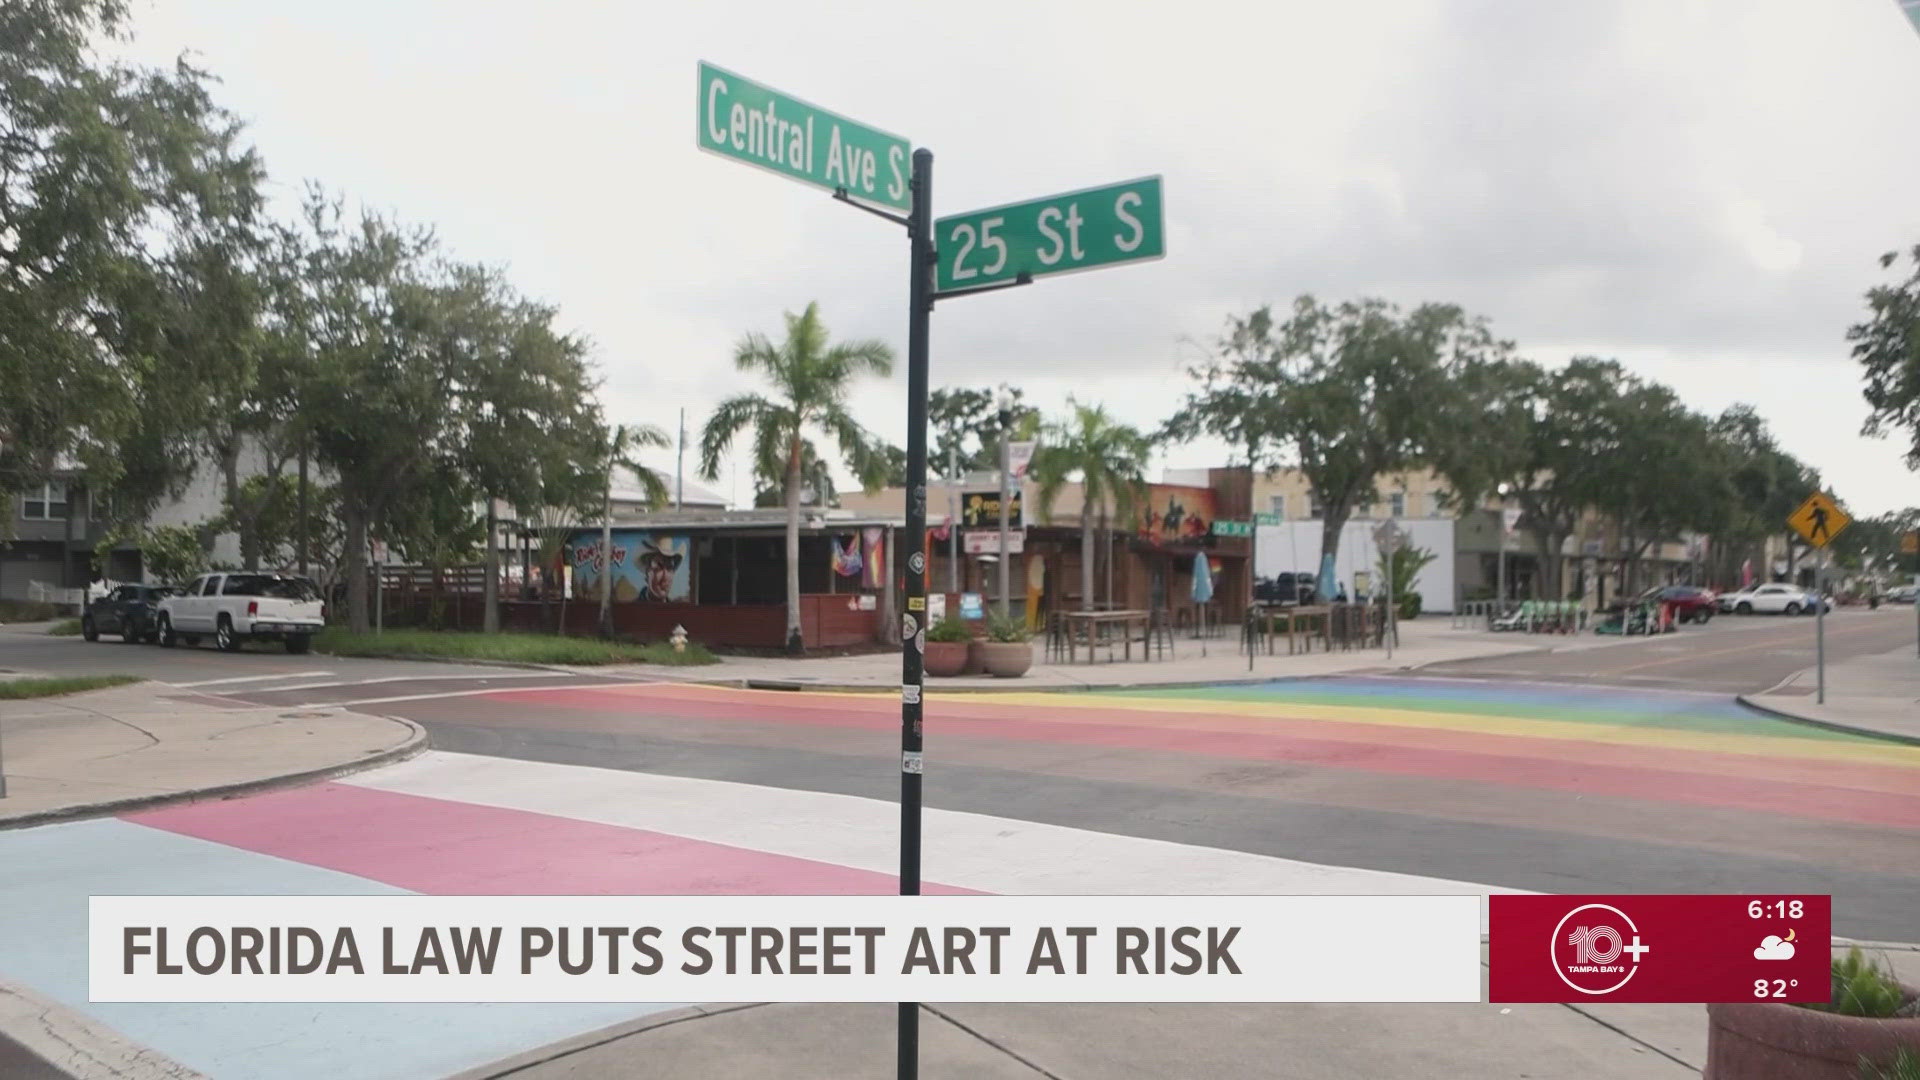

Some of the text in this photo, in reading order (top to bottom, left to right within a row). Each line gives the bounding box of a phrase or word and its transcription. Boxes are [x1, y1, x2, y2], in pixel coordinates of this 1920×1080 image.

[708, 78, 904, 201] Central Ave S
[951, 191, 1144, 281] 25 St S
